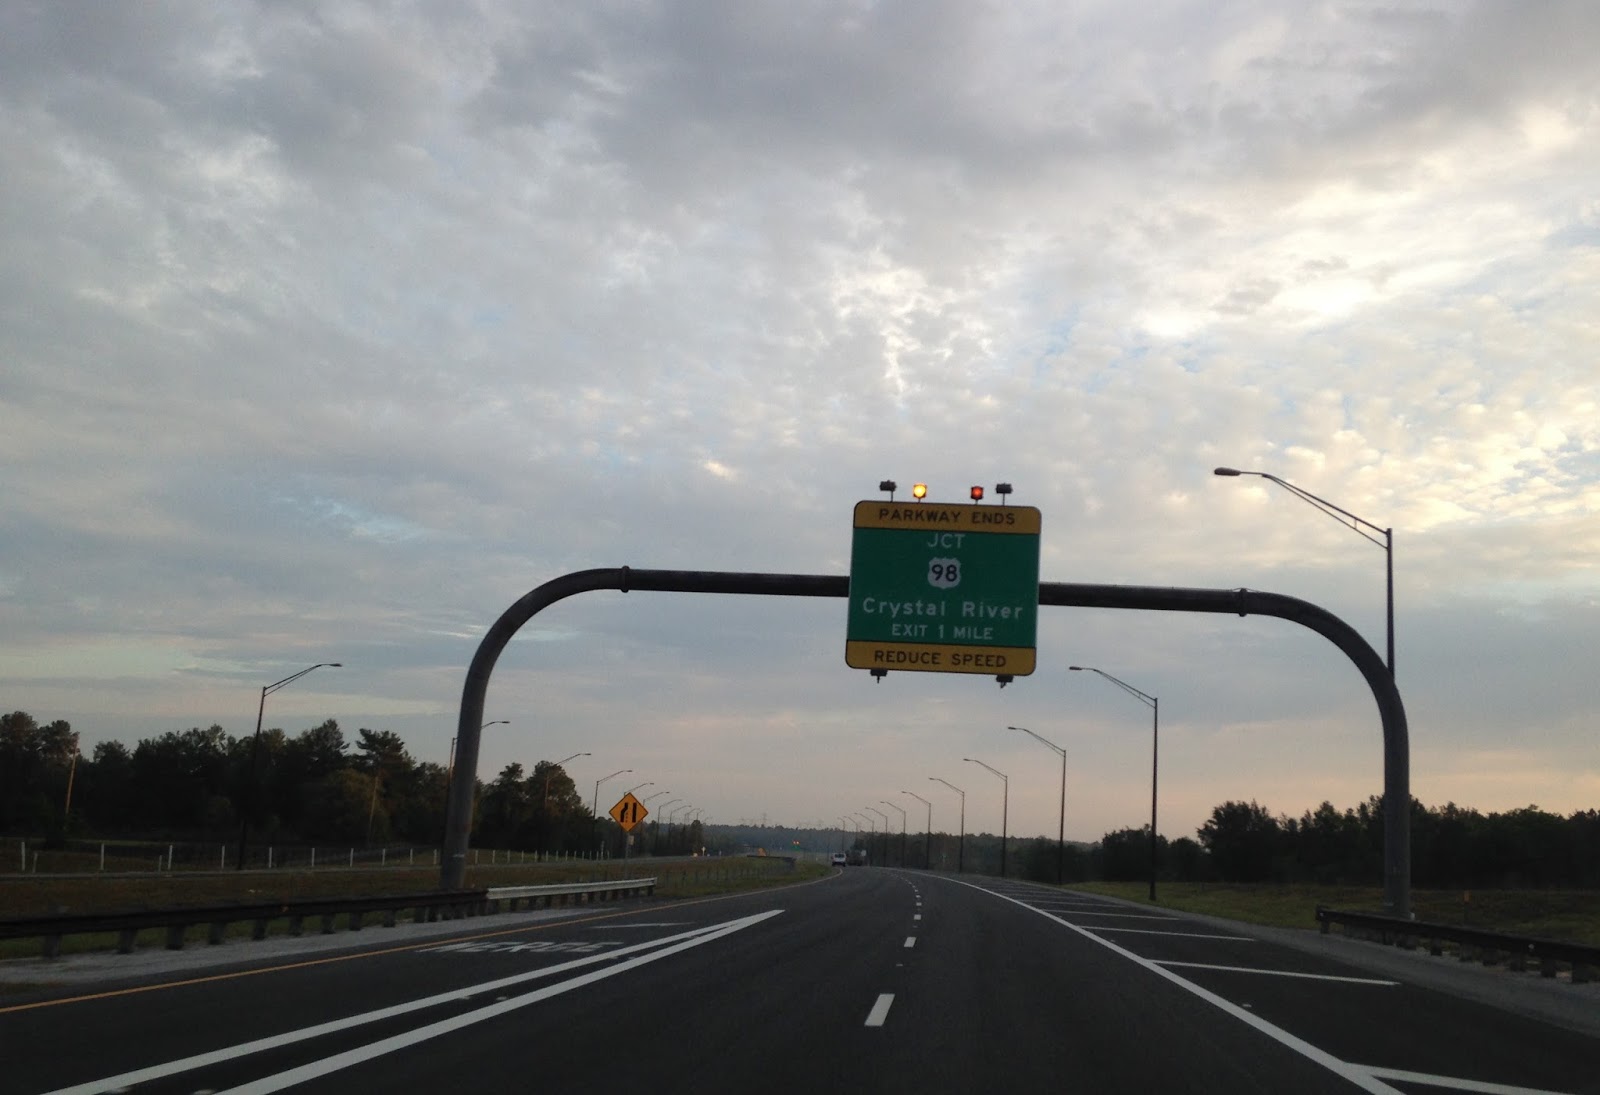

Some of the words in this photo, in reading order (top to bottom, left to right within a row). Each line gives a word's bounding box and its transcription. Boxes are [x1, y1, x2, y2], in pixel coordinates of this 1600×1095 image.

[879, 508, 961, 523] PARKWAY
[971, 511, 1016, 525] ENDS
[927, 533, 966, 549] JCT
[931, 564, 958, 582] 98
[862, 597, 945, 619] Crystal
[961, 601, 1023, 620] River
[891, 623, 928, 637] EXIT
[938, 625, 944, 639] 1
[953, 626, 994, 640] MILE
[874, 650, 941, 665] REDUCE
[951, 653, 1007, 668] SPEED
[414, 941, 624, 953] MERGE
